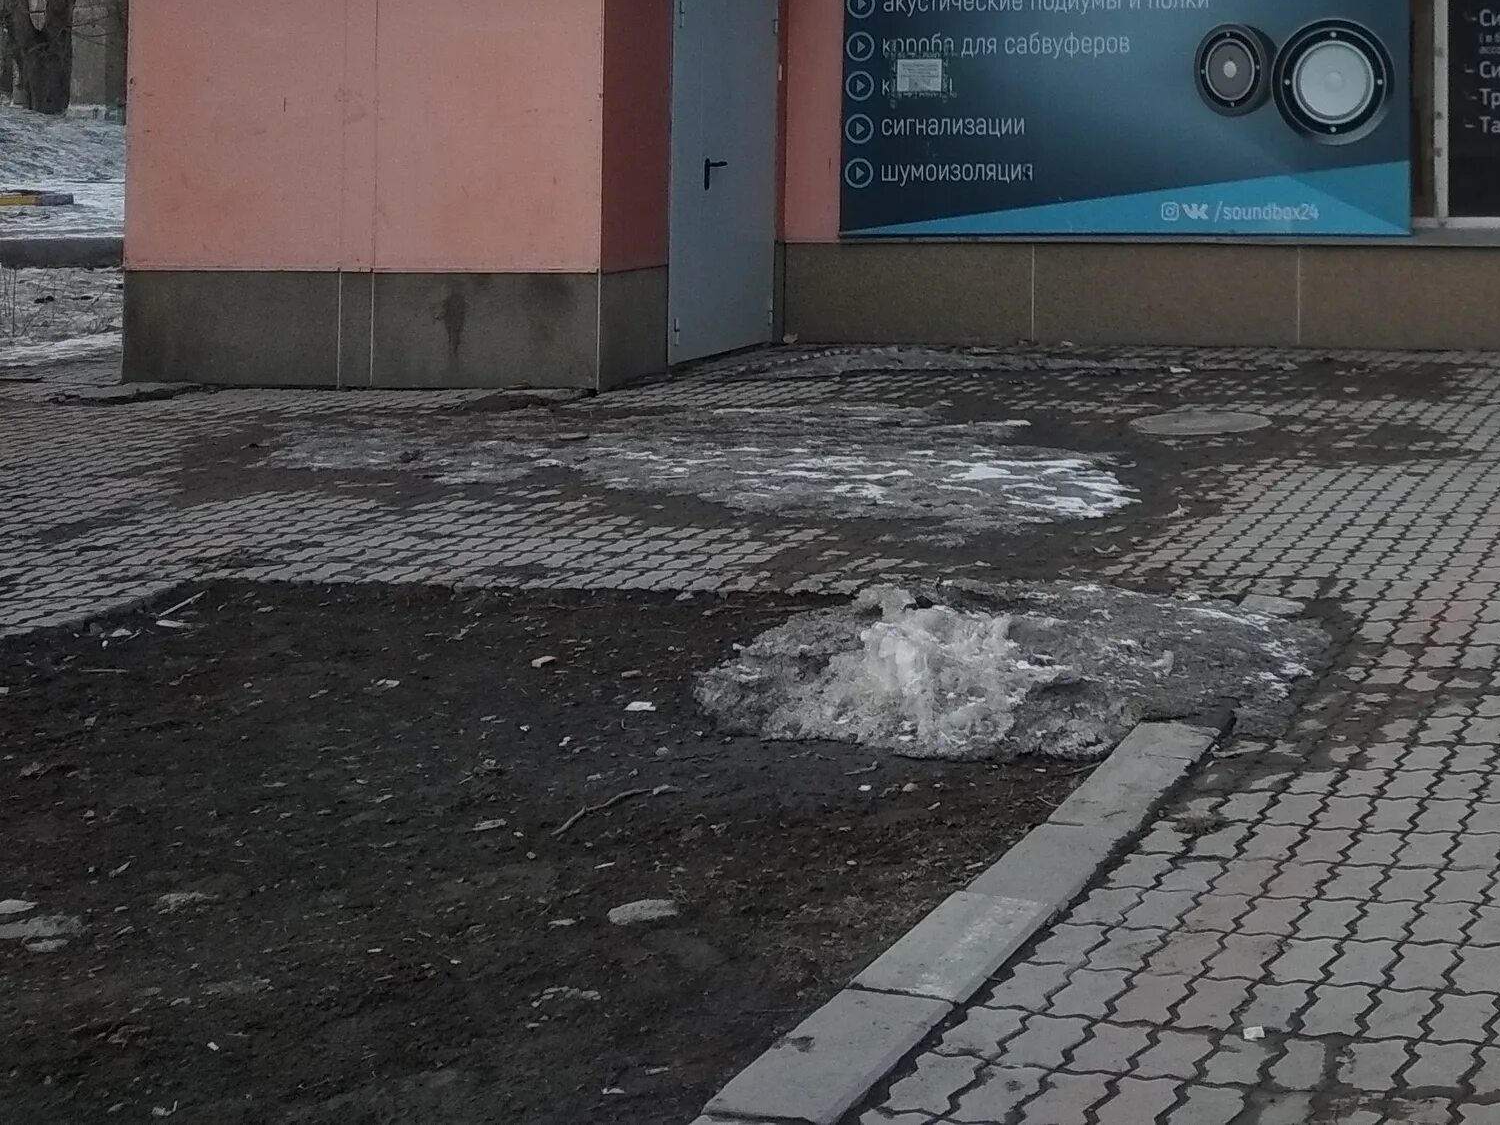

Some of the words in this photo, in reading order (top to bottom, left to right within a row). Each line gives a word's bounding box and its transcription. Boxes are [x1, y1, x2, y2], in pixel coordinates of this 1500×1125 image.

[960, 37, 997, 58] для
[1004, 32, 1130, 58] сабвуферов
[881, 117, 1025, 137] сигнализации
[881, 163, 1033, 186] шумоизоляция
